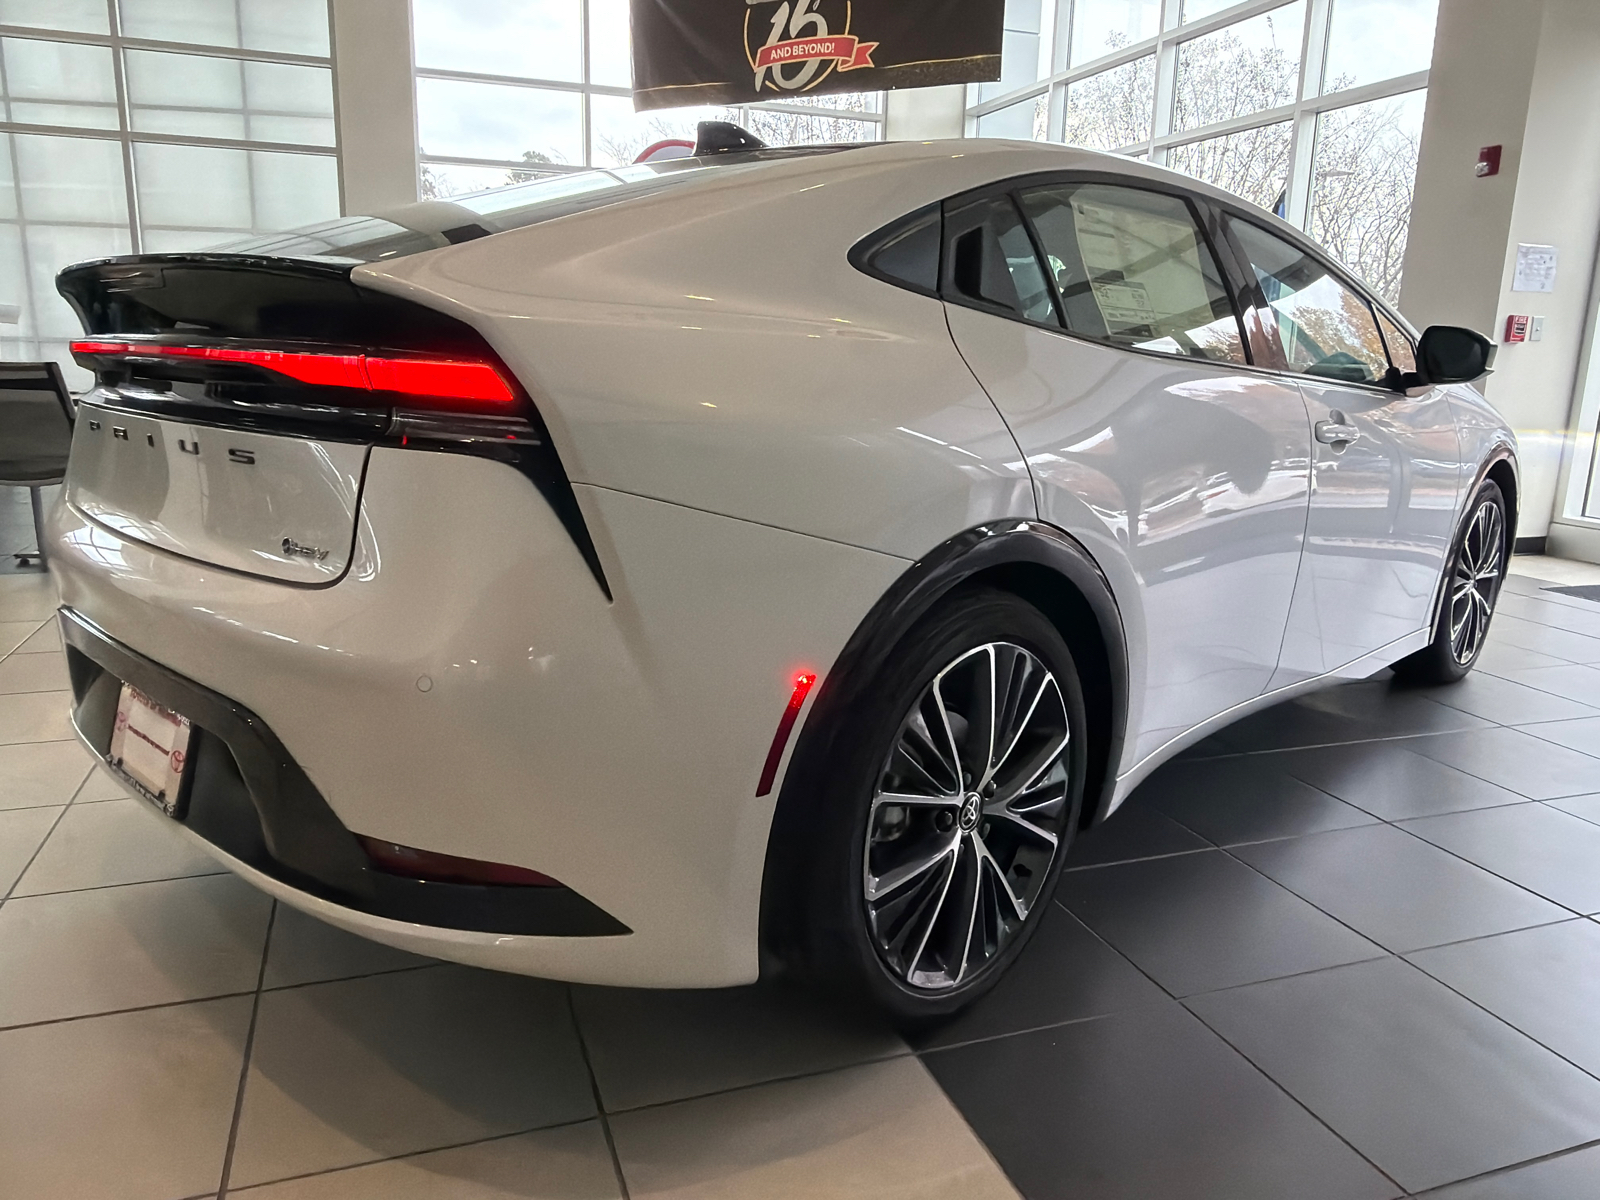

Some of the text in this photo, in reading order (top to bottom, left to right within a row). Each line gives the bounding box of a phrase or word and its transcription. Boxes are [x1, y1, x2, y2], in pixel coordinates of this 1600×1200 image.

[770, 42, 836, 60] AND BEYOND!
[89, 419, 256, 465] PRIUS
